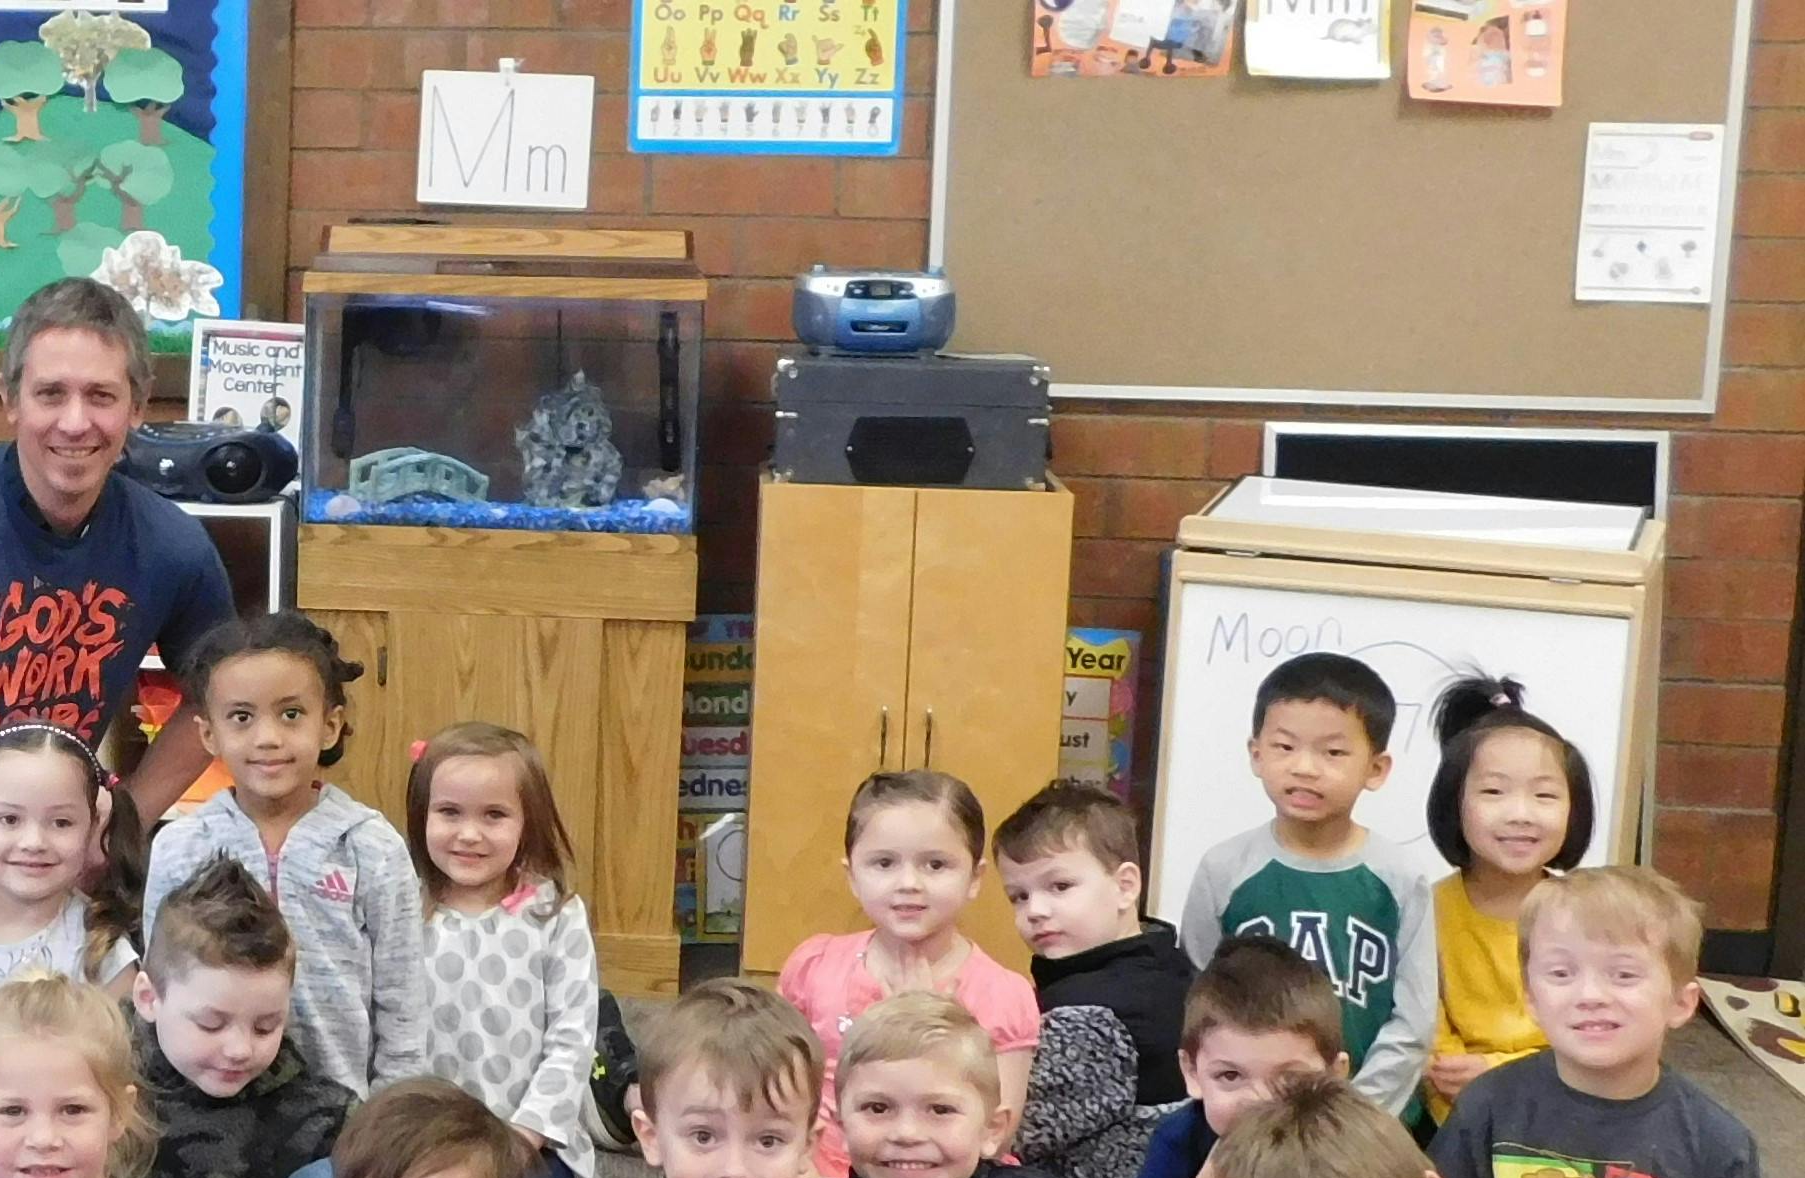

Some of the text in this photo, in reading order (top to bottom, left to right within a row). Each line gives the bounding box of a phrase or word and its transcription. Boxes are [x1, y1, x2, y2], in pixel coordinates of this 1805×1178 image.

[654, 5, 880, 29] Oo Pp Qq Rr Ss Tt
[653, 67, 683, 84] Uu
[695, 67, 721, 84] Vv
[728, 67, 767, 84] Ww
[815, 67, 840, 88] Yy
[854, 68, 880, 85] Zz
[427, 84, 568, 193] Mm
[213, 340, 301, 359] Music and
[210, 359, 303, 378] Movement
[223, 377, 285, 394] Center
[1207, 612, 1344, 665] Moon
[1066, 647, 1126, 671] Year
